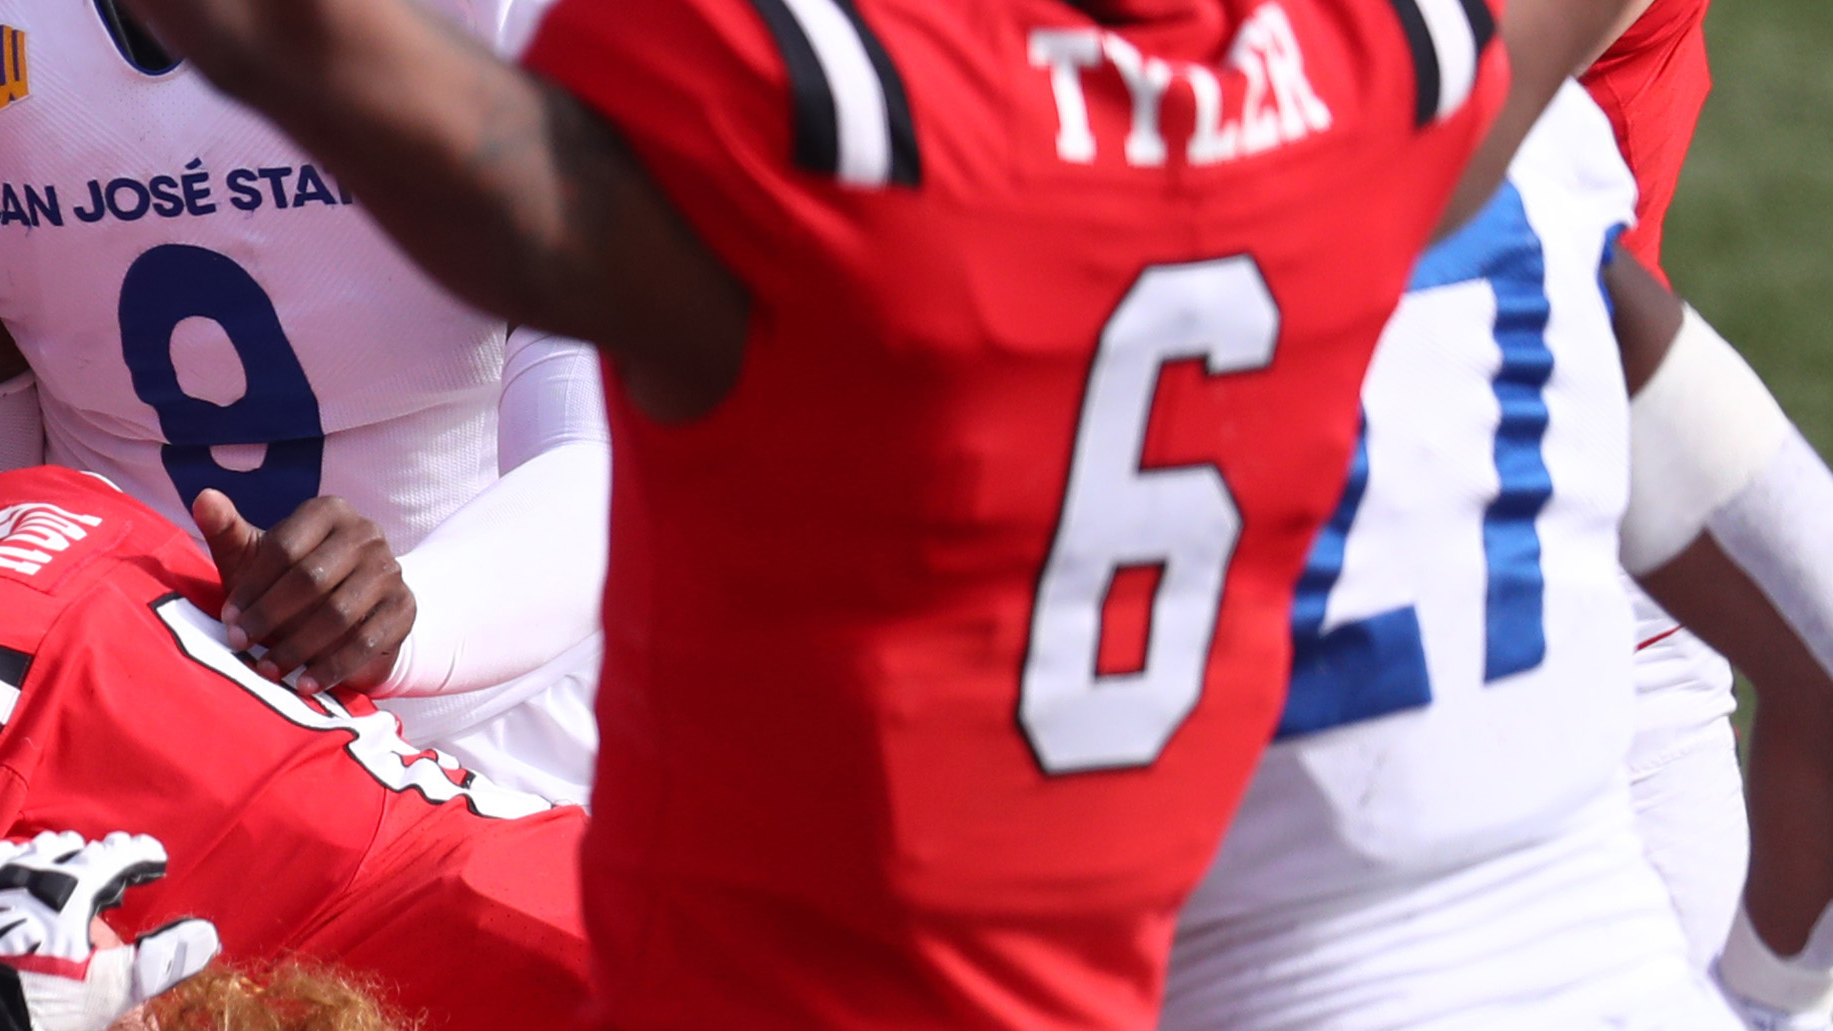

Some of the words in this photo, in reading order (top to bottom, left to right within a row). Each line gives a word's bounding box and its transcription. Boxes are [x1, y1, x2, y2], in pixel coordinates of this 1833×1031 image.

[73, 157, 217, 223] JOSÉ
[226, 164, 357, 211] STA
[1026, 0, 1333, 167] TYLER
[118, 243, 325, 532] 9
[1018, 252, 1281, 774] 6
